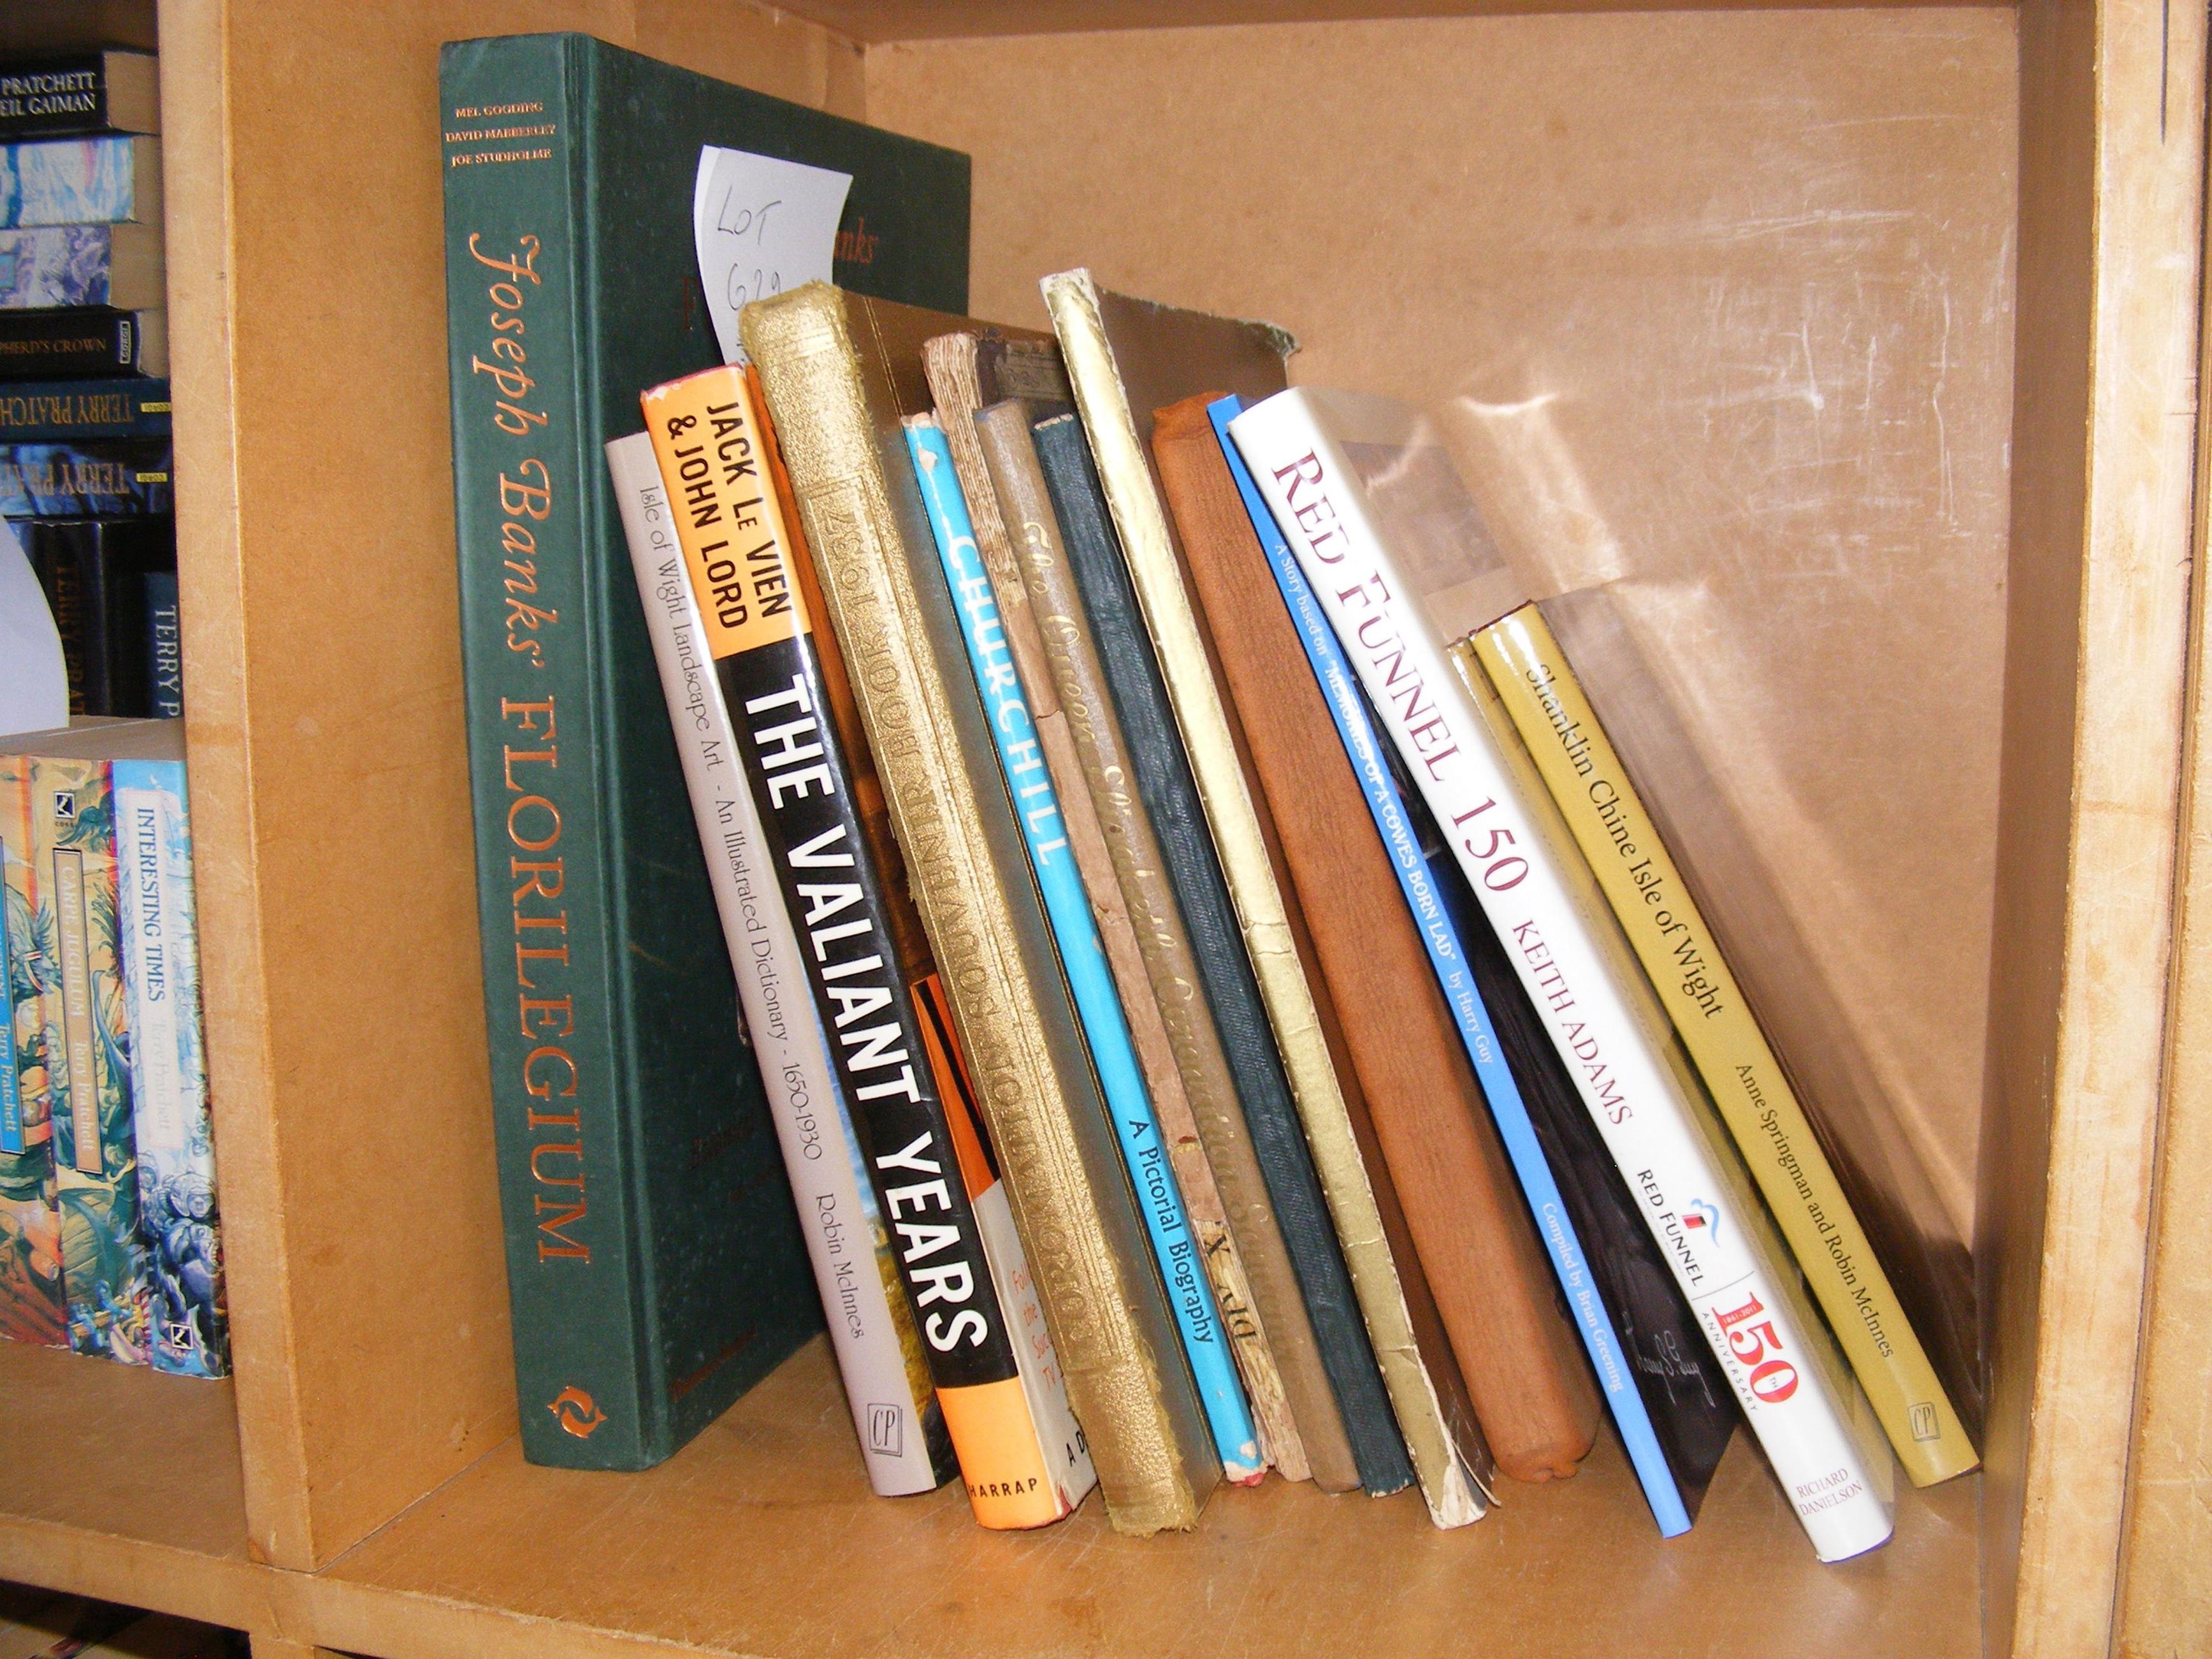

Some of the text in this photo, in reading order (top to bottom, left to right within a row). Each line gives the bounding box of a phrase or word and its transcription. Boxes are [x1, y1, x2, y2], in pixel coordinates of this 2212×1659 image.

[1, 71, 96, 96] PRATCHETT
[29, 92, 96, 115] GAIMAN
[455, 101, 544, 119] MEL GOODING
[445, 124, 556, 143] DAVID MABBERLEY
[451, 148, 552, 168] JOE STUDHOLME
[718, 185, 781, 245] LOT
[53, 338, 107, 353] CROWN
[76, 393, 134, 424] TERRY
[60, 462, 130, 496] TERRY
[639, 484, 665, 523] Isle
[667, 414, 748, 629] & JOHN LORD
[706, 402, 757, 485] JACK
[746, 539, 793, 618] VIEN
[650, 530, 672, 551] of
[827, 509, 880, 612] 1937
[1275, 542, 1290, 556] A
[656, 558, 688, 619] Wight
[1281, 557, 1302, 594] Story
[1023, 521, 1053, 602] The
[1044, 614, 1095, 744] Queen
[1296, 594, 1322, 635] based
[155, 605, 179, 694] TERRY
[1313, 635, 1327, 656] on
[672, 623, 711, 732] Landscape
[861, 627, 920, 759] BOOK
[468, 231, 591, 1264] Joseph Banks' FLORILEGIUM
[701, 739, 725, 771] Art
[1365, 762, 1385, 789] OF
[715, 798, 737, 824] An
[1271, 447, 1633, 1126] RED FUNNEL 150 KEITH ADAMS
[1374, 790, 1393, 804] A
[1382, 803, 1417, 869] COWES
[136, 808, 163, 937] INTERESTING
[723, 829, 767, 934] Illustrated
[899, 772, 997, 1018] SOUVENIR
[1407, 867, 1438, 920] BORN
[948, 534, 1214, 1344] CHURCHILL A Pictorial Biography
[145, 943, 166, 1003] TIMES
[750, 937, 789, 1042] Dictionary
[1449, 970, 1463, 990] by
[61, 866, 94, 1150] CARPE JUGULUM Terry Pratchett
[745, 672, 988, 1352] THE VALIANT YEARS
[1457, 991, 1480, 1041] Harry
[1525, 663, 1894, 1359] Shanklin Chine Isle of Wight Anne Springman and Robin McInnes
[1475, 1034, 1494, 1066] Guy
[0, 1065, 17, 1133] Pratchett
[781, 1061, 822, 1162] 1650-1930
[816, 1192, 842, 1256] Robin
[1637, 1169, 1665, 1206] RED
[1659, 1212, 1704, 1287] FUNNEL
[833, 1261, 865, 1340] McInnes
[1542, 1202, 1624, 1394] Compiled by Brian Greening
[1702, 1312, 1759, 1410] ANNIVERSARY
[1711, 1291, 1799, 1403] 150
[1066, 1442, 1076, 1467] A
[1796, 1468, 1848, 1498] RICHARD
[969, 1477, 1038, 1499] HARRAP
[1799, 1480, 1862, 1516] DANIELSON
